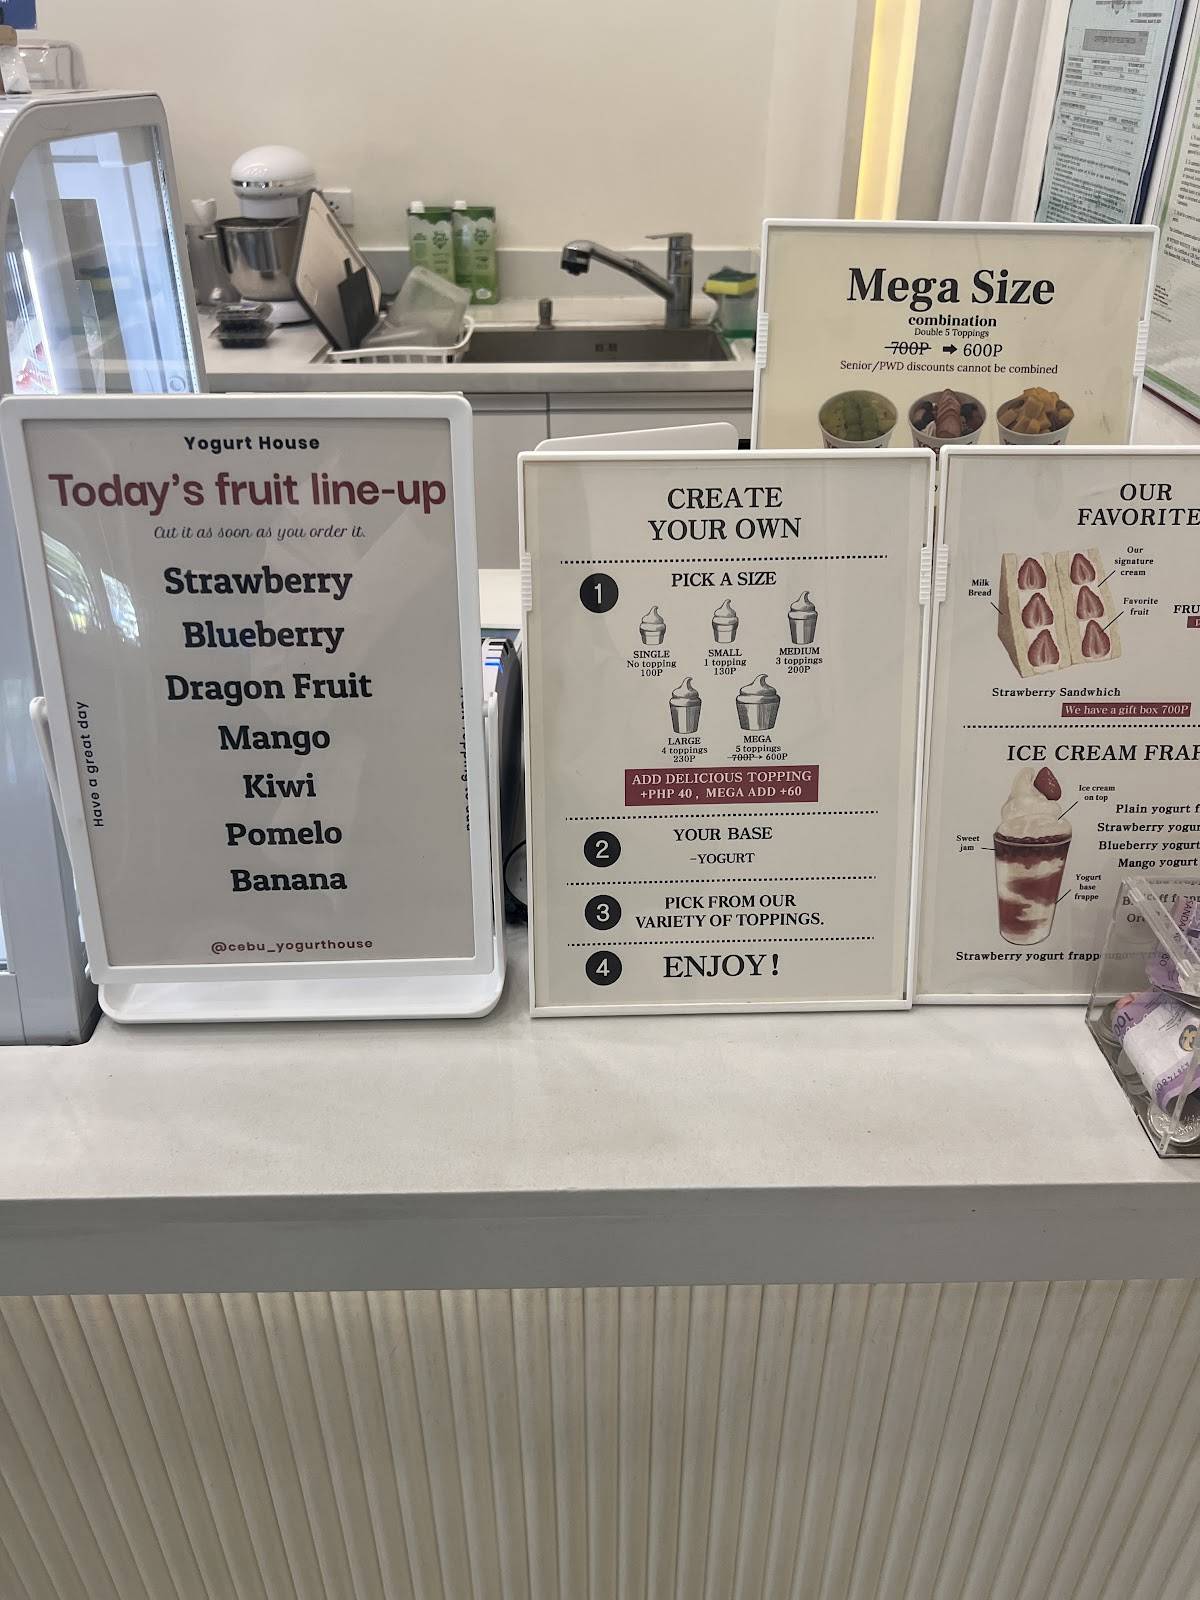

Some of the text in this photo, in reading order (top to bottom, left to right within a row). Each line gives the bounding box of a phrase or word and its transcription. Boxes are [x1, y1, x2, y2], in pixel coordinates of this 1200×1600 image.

[847, 268, 1054, 312] Mega Size
[909, 315, 996, 326] combination
[915, 328, 942, 336] Double
[952, 329, 989, 339] Toppings
[964, 344, 1002, 357] 600P
[841, 361, 904, 372] Senior/PWD
[907, 362, 954, 371] discounts
[992, 362, 1006, 373] be
[1009, 365, 1057, 374] combined
[184, 436, 319, 454] Yogurt House
[215, 472, 299, 505] fruit
[312, 473, 446, 514] line-up
[668, 487, 782, 509] CREATE
[1120, 484, 1172, 501] OUR
[155, 525, 365, 541] Cut it as soon as you order it.
[648, 518, 801, 540] YOUR OWN
[1115, 558, 1153, 566] signature
[164, 566, 352, 600] Strawberry
[672, 572, 776, 587] PICK A SIZE
[182, 620, 344, 653] Blueberry
[709, 649, 742, 657] SMALL
[780, 647, 819, 655] MEDIUM
[643, 660, 676, 668] topping
[712, 658, 746, 668] topping
[785, 657, 822, 665] toppings
[165, 672, 372, 706] Dragon Fruit
[993, 688, 1120, 697] Strawberry Sandwhich
[1065, 706, 1080, 714] We
[1083, 706, 1107, 714] have
[1118, 705, 1137, 716] gift
[1140, 705, 1157, 714] box
[1162, 705, 1189, 714] 700P
[218, 726, 330, 755] Mango
[668, 737, 701, 745] LARGE
[744, 735, 771, 743] MEGA
[670, 747, 707, 757] toppings
[743, 745, 781, 753] toppings
[1007, 745, 1046, 761] ICE
[1055, 745, 1137, 760] CREAM
[76, 701, 104, 827] Have a great day
[632, 771, 811, 784] ADD DELICIOUS TOPPING
[243, 773, 316, 798] Kiwi
[641, 789, 674, 799] +PHP
[706, 788, 744, 797] MEGA
[748, 787, 775, 796] ADD
[780, 786, 801, 796] +60
[1116, 804, 1146, 813] Plain
[1152, 805, 1190, 814] yogurt
[225, 820, 342, 846] Pomelo
[674, 827, 772, 841] YOUR BASE
[1098, 823, 1164, 832] Strawberry
[596, 840, 609, 858] 2
[960, 844, 974, 852] jam
[1099, 841, 1158, 850] Blueberry
[1118, 858, 1198, 869] Mango yogurt
[230, 870, 347, 892] Banana
[1076, 874, 1101, 882] Yogurt
[665, 895, 796, 909] PICK FROM OUR
[1075, 893, 1098, 901] frappe
[596, 903, 610, 922] 3
[636, 913, 824, 928] VARIETY OF TOPPINGS.
[212, 940, 372, 954] @cebu_yogurthouse
[957, 952, 1022, 962] Strawberry
[1026, 952, 1065, 961] yogurt
[596, 959, 610, 976] 4
